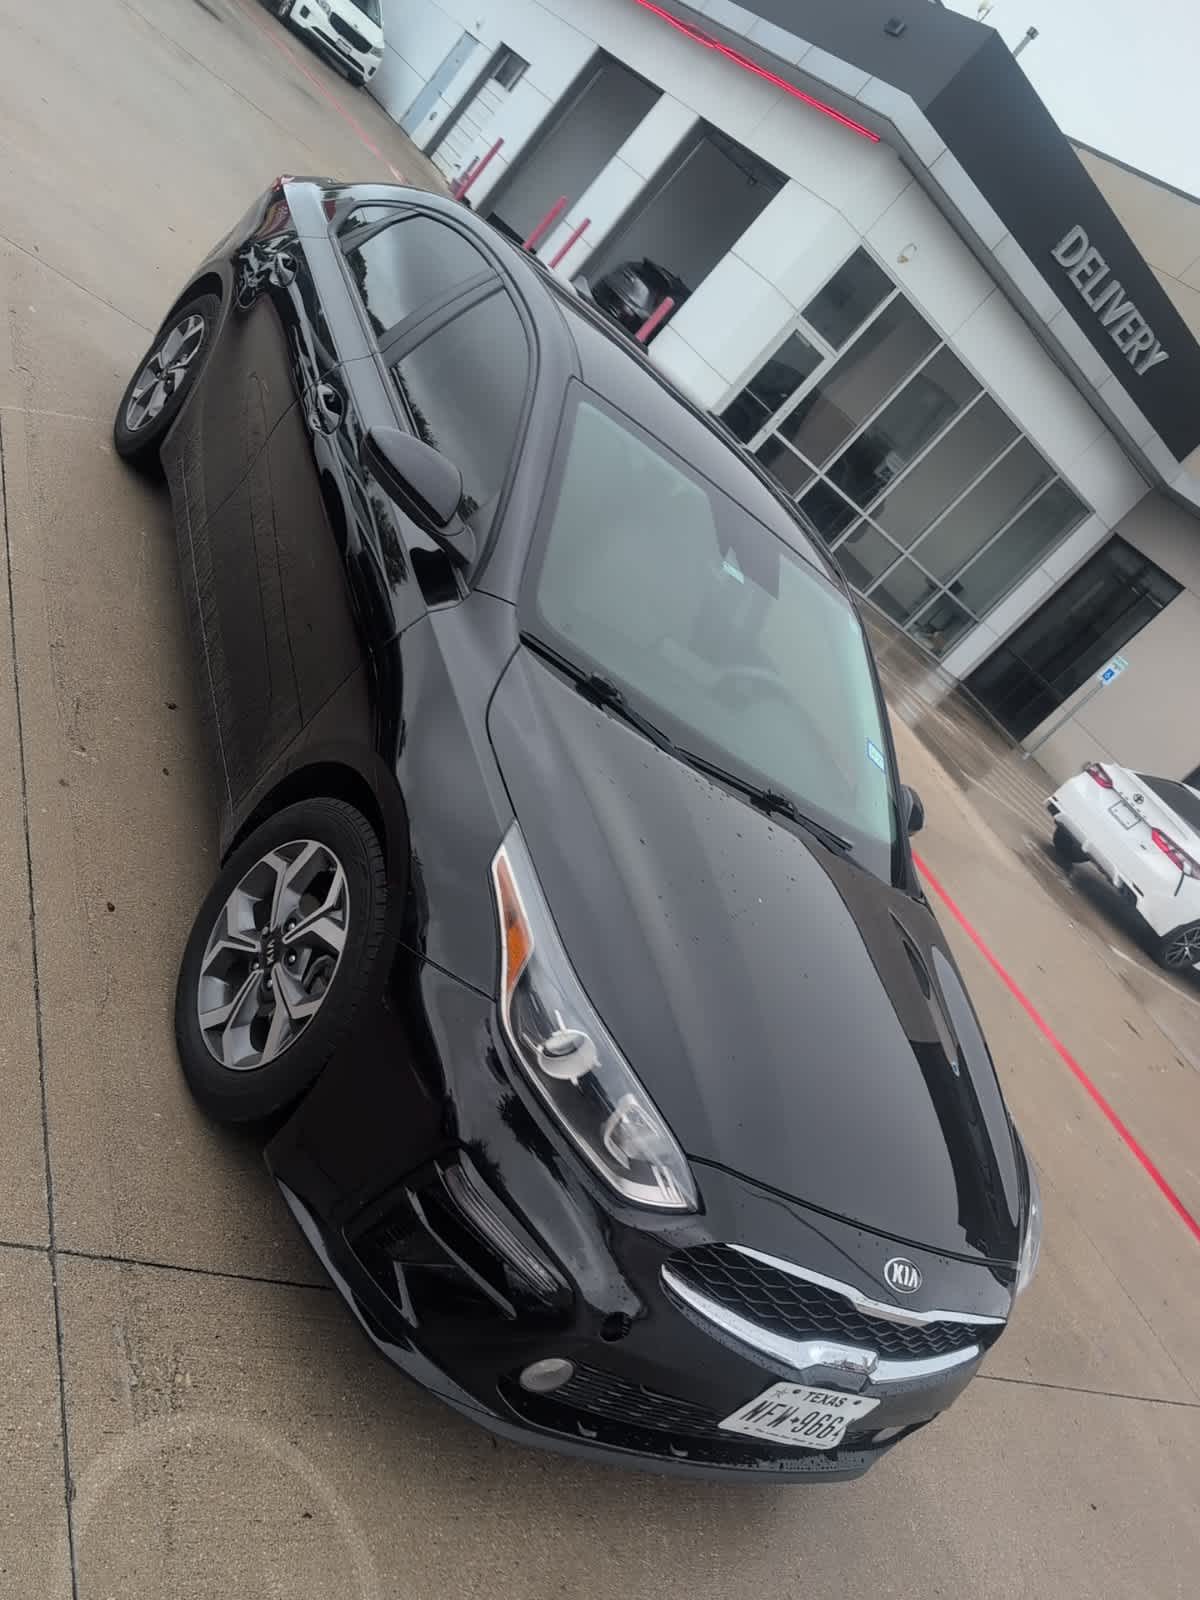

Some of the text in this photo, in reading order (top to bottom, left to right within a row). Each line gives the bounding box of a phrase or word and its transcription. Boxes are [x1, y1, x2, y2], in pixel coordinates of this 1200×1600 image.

[1051, 224, 1169, 376] DELIVERY
[892, 1262, 918, 1288] KIA
[803, 1391, 847, 1408] TEXAS
